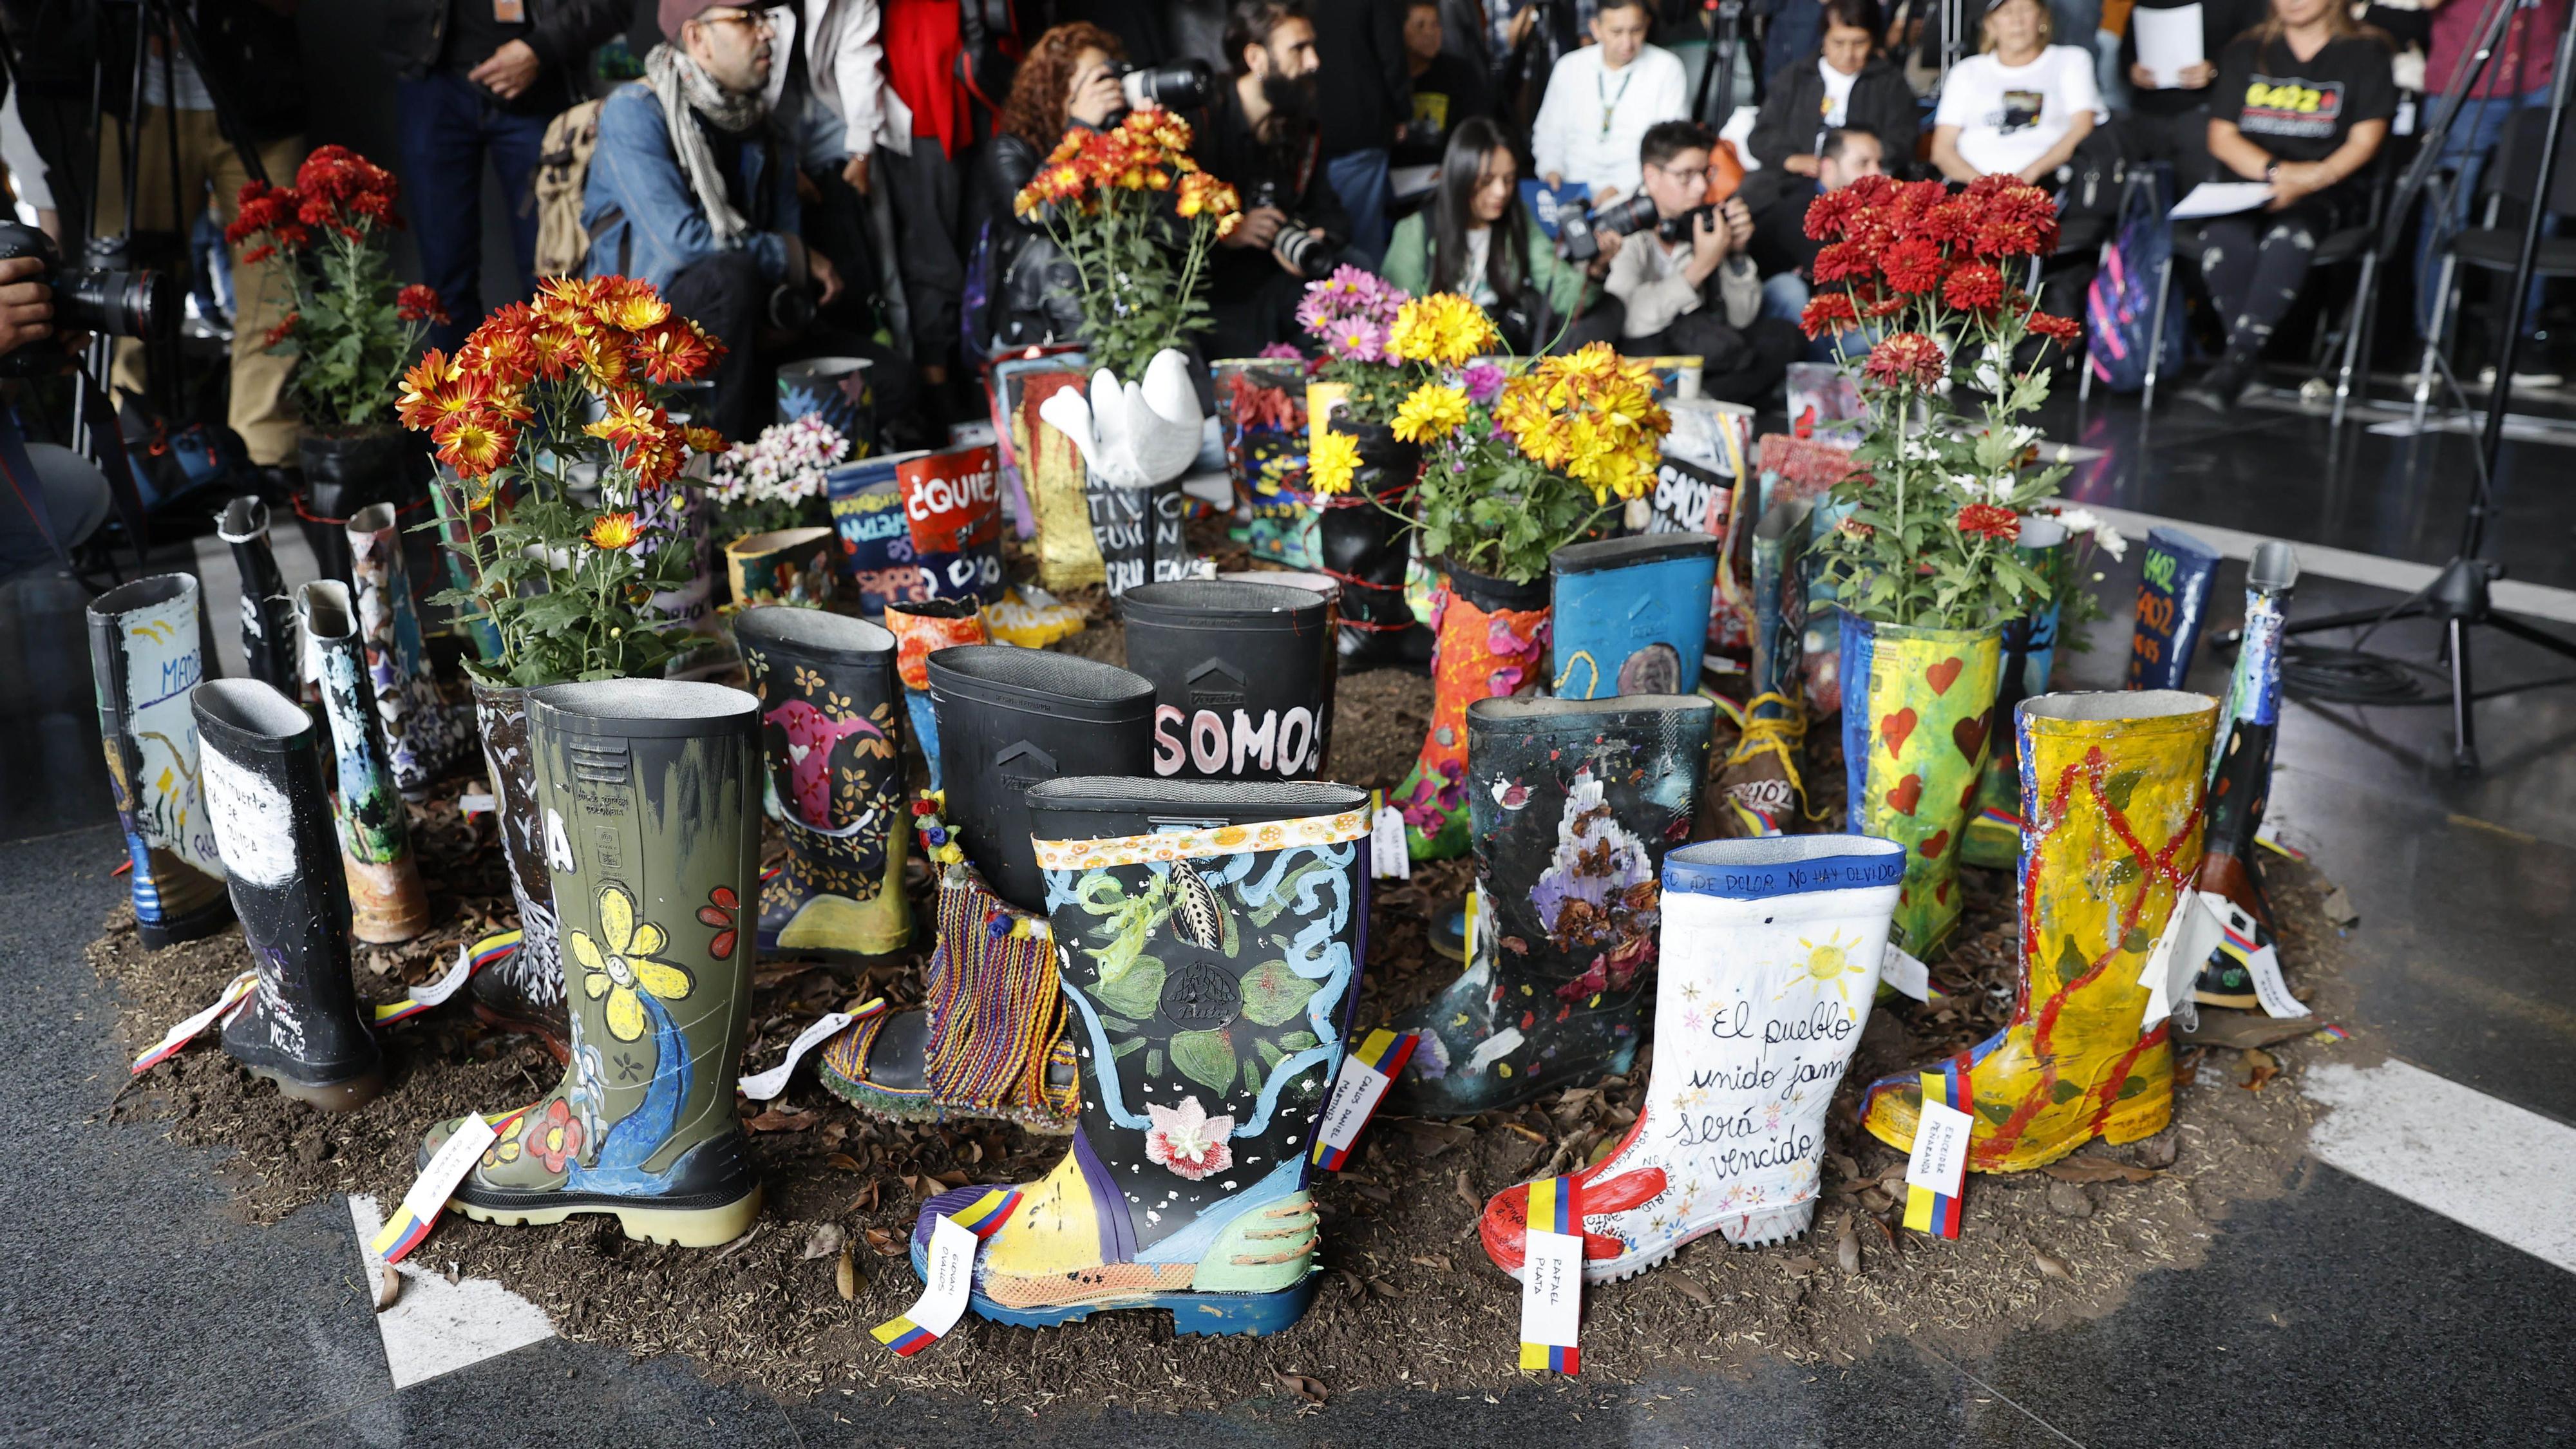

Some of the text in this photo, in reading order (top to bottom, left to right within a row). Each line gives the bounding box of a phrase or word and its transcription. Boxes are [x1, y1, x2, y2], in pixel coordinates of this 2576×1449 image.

[1788, 870, 1807, 889] NO
[1712, 1001, 1857, 1062] El pueblo
[1687, 1057, 1783, 1090] unido
[1324, 1079, 1350, 1122] MARTINEZ
[1331, 1075, 1372, 1139] CARLOS DANIEL
[1665, 1105, 1762, 1147] será
[1534, 1257, 1546, 1295] PLATA
[1550, 1258, 1562, 1305] RAFAEL
